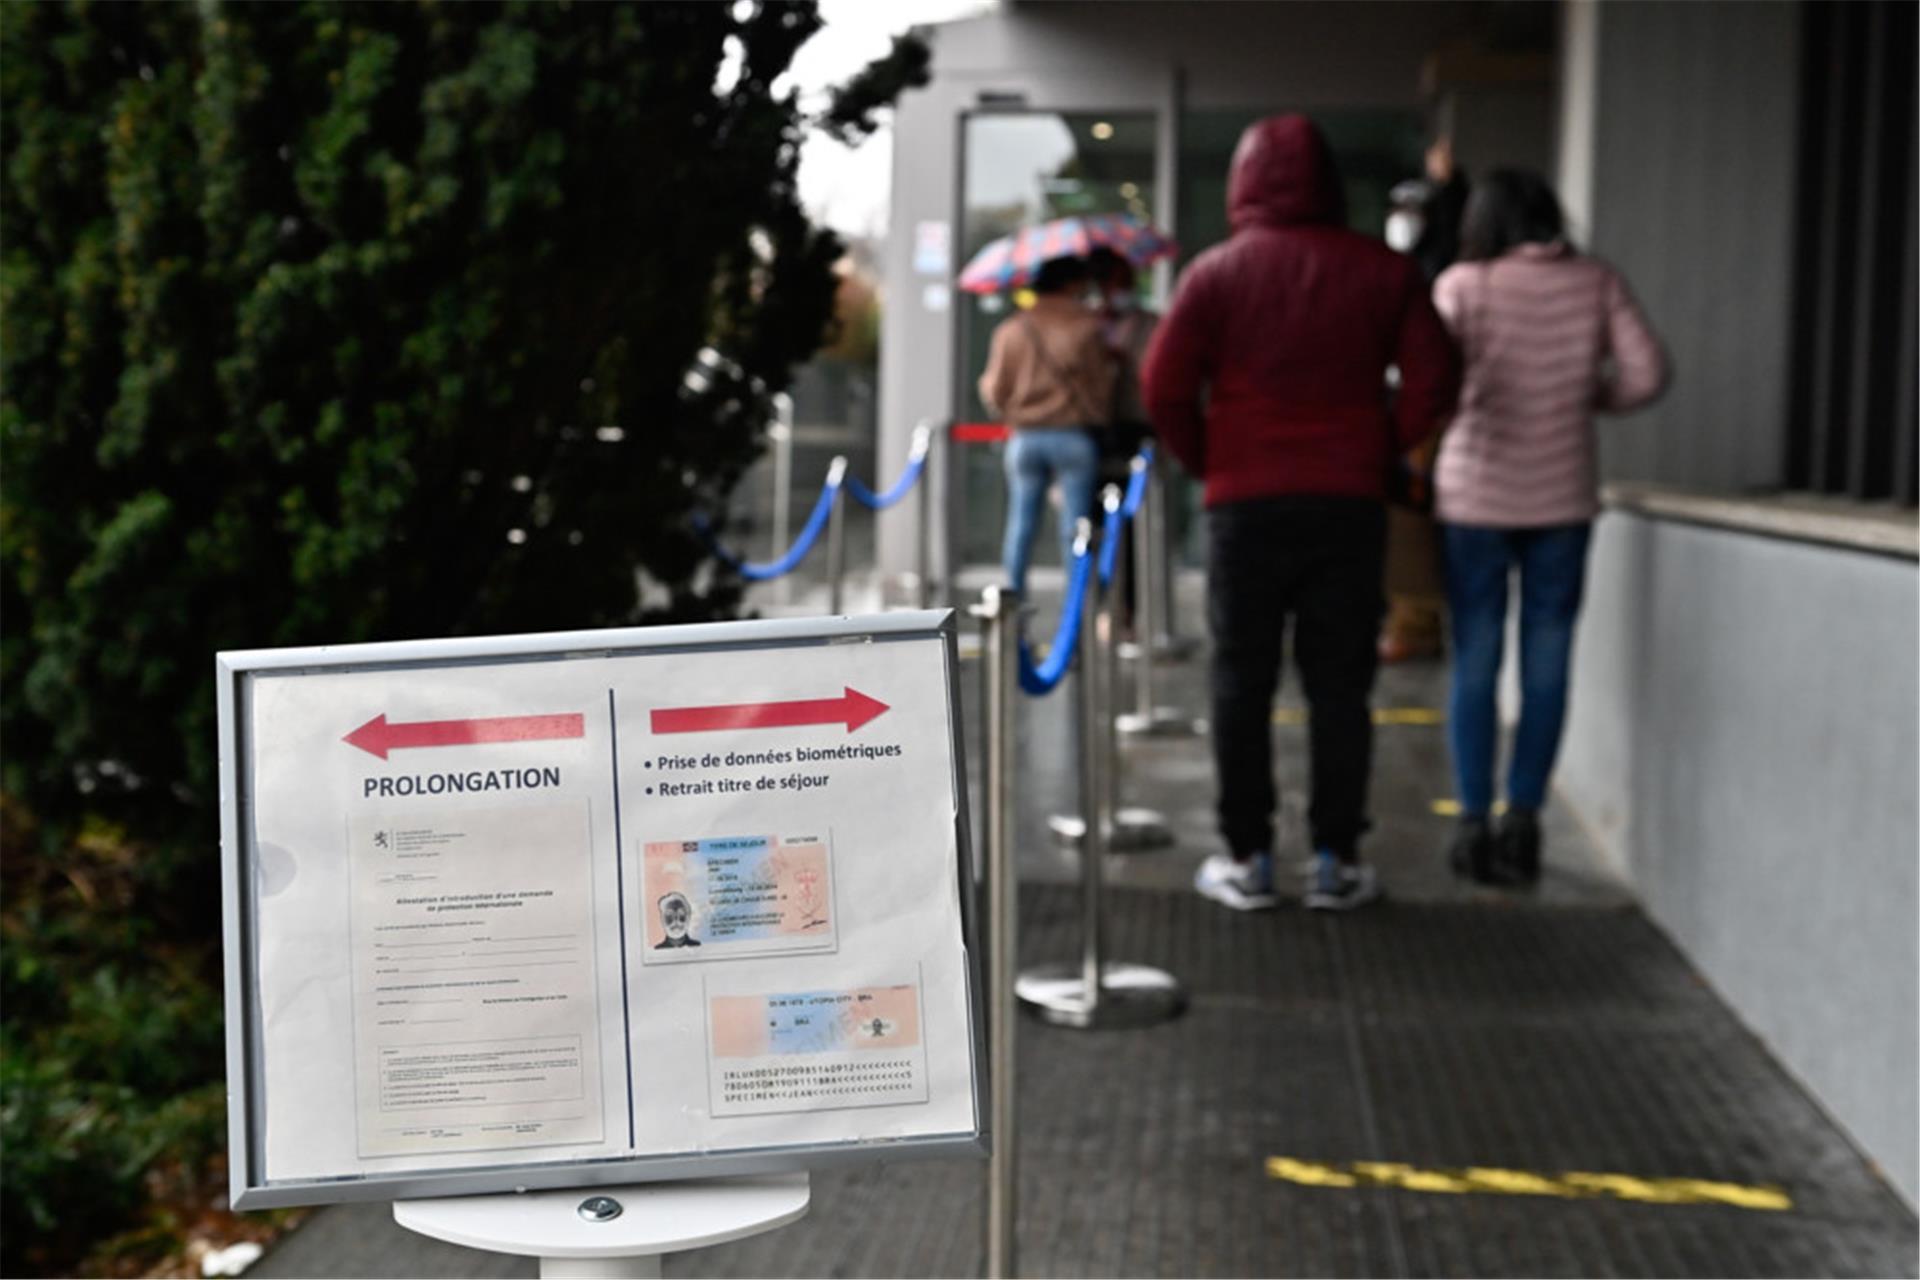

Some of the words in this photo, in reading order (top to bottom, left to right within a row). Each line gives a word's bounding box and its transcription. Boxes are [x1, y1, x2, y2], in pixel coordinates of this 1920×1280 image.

[657, 755, 697, 770] Prise
[701, 753, 721, 768] de
[725, 749, 792, 766] données
[796, 743, 902, 761] biométriques
[363, 766, 561, 798] PROLONGATION
[659, 779, 714, 796] Retrait
[717, 778, 752, 793] titre
[756, 776, 776, 790] de
[780, 773, 830, 791] séjour
